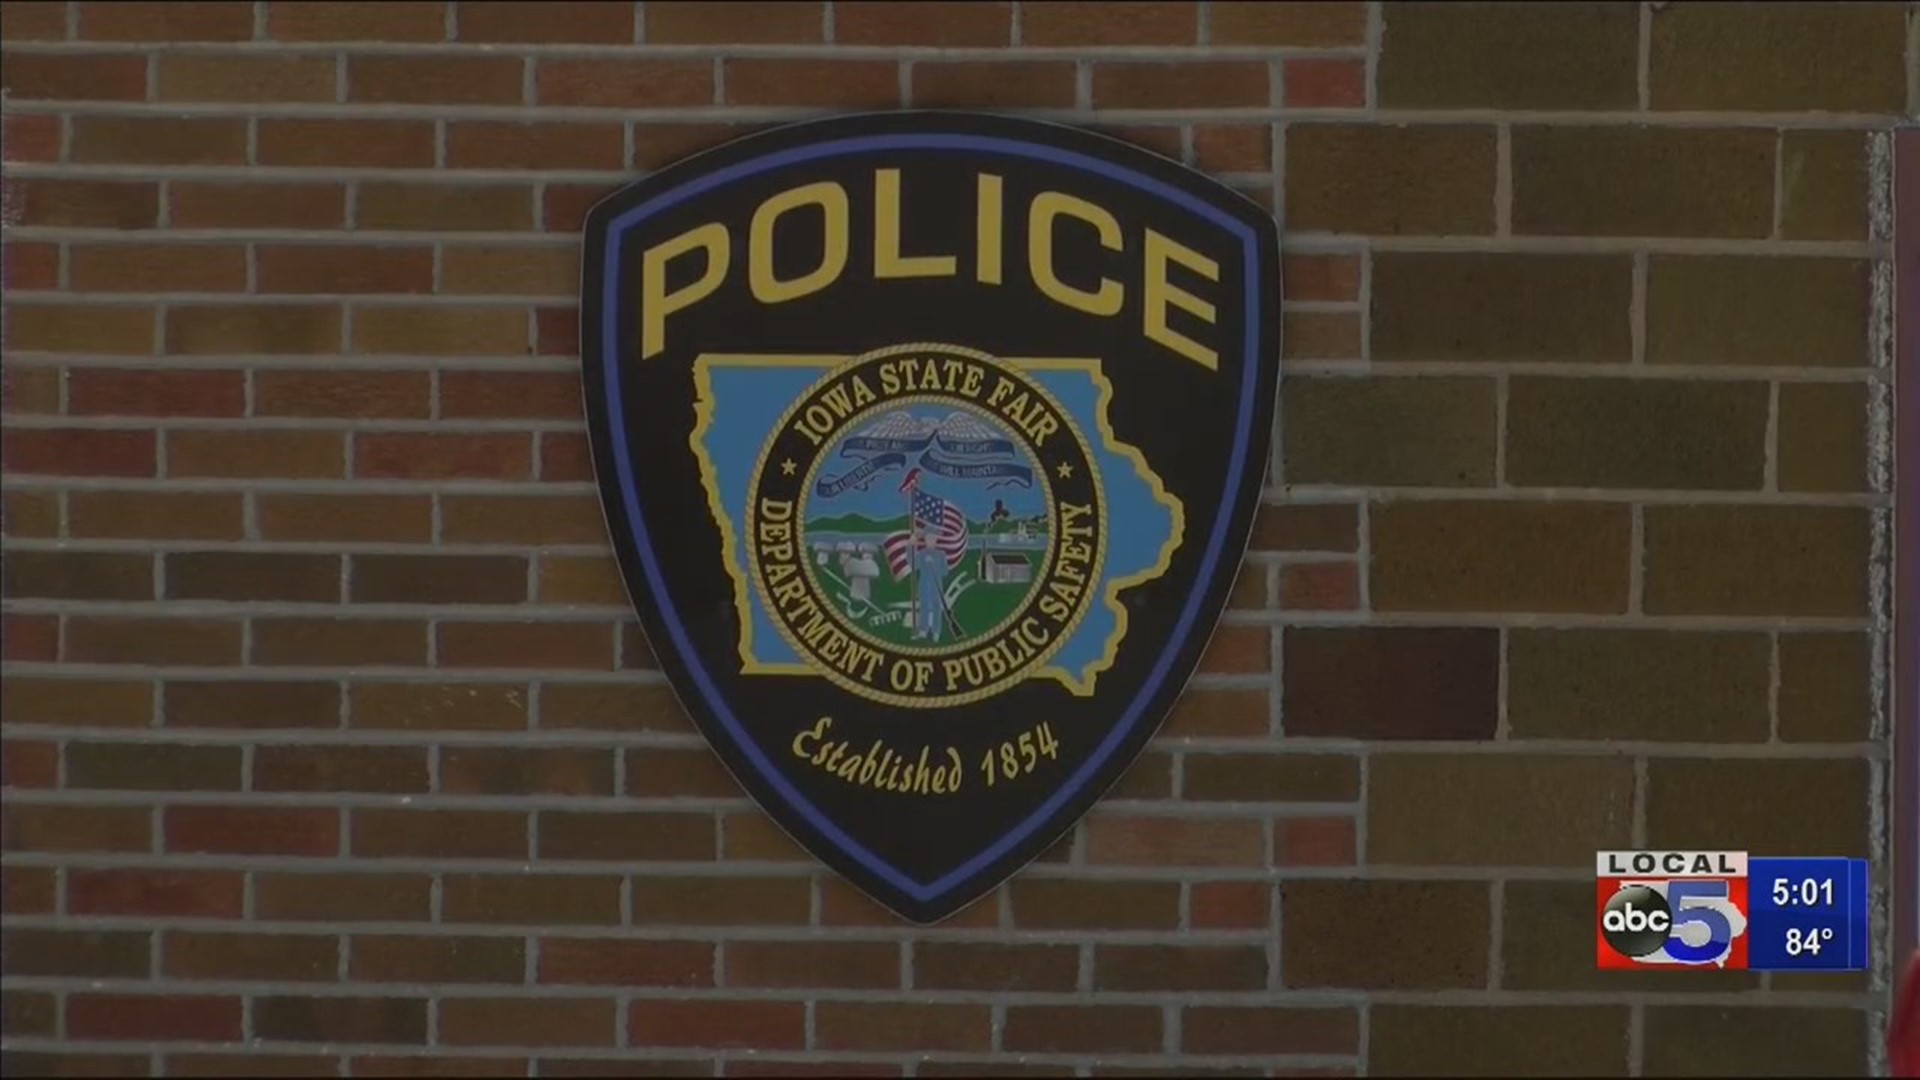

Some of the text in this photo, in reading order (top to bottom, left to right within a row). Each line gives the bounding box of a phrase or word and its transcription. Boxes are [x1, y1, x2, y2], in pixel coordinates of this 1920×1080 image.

[642, 168, 1220, 370] POLICE
[793, 358, 1060, 447] IOWA STATE FAIR
[760, 497, 1093, 694] DEPARTMENT OF PUBLIC SAFETY
[792, 717, 1059, 795] Established 1854
